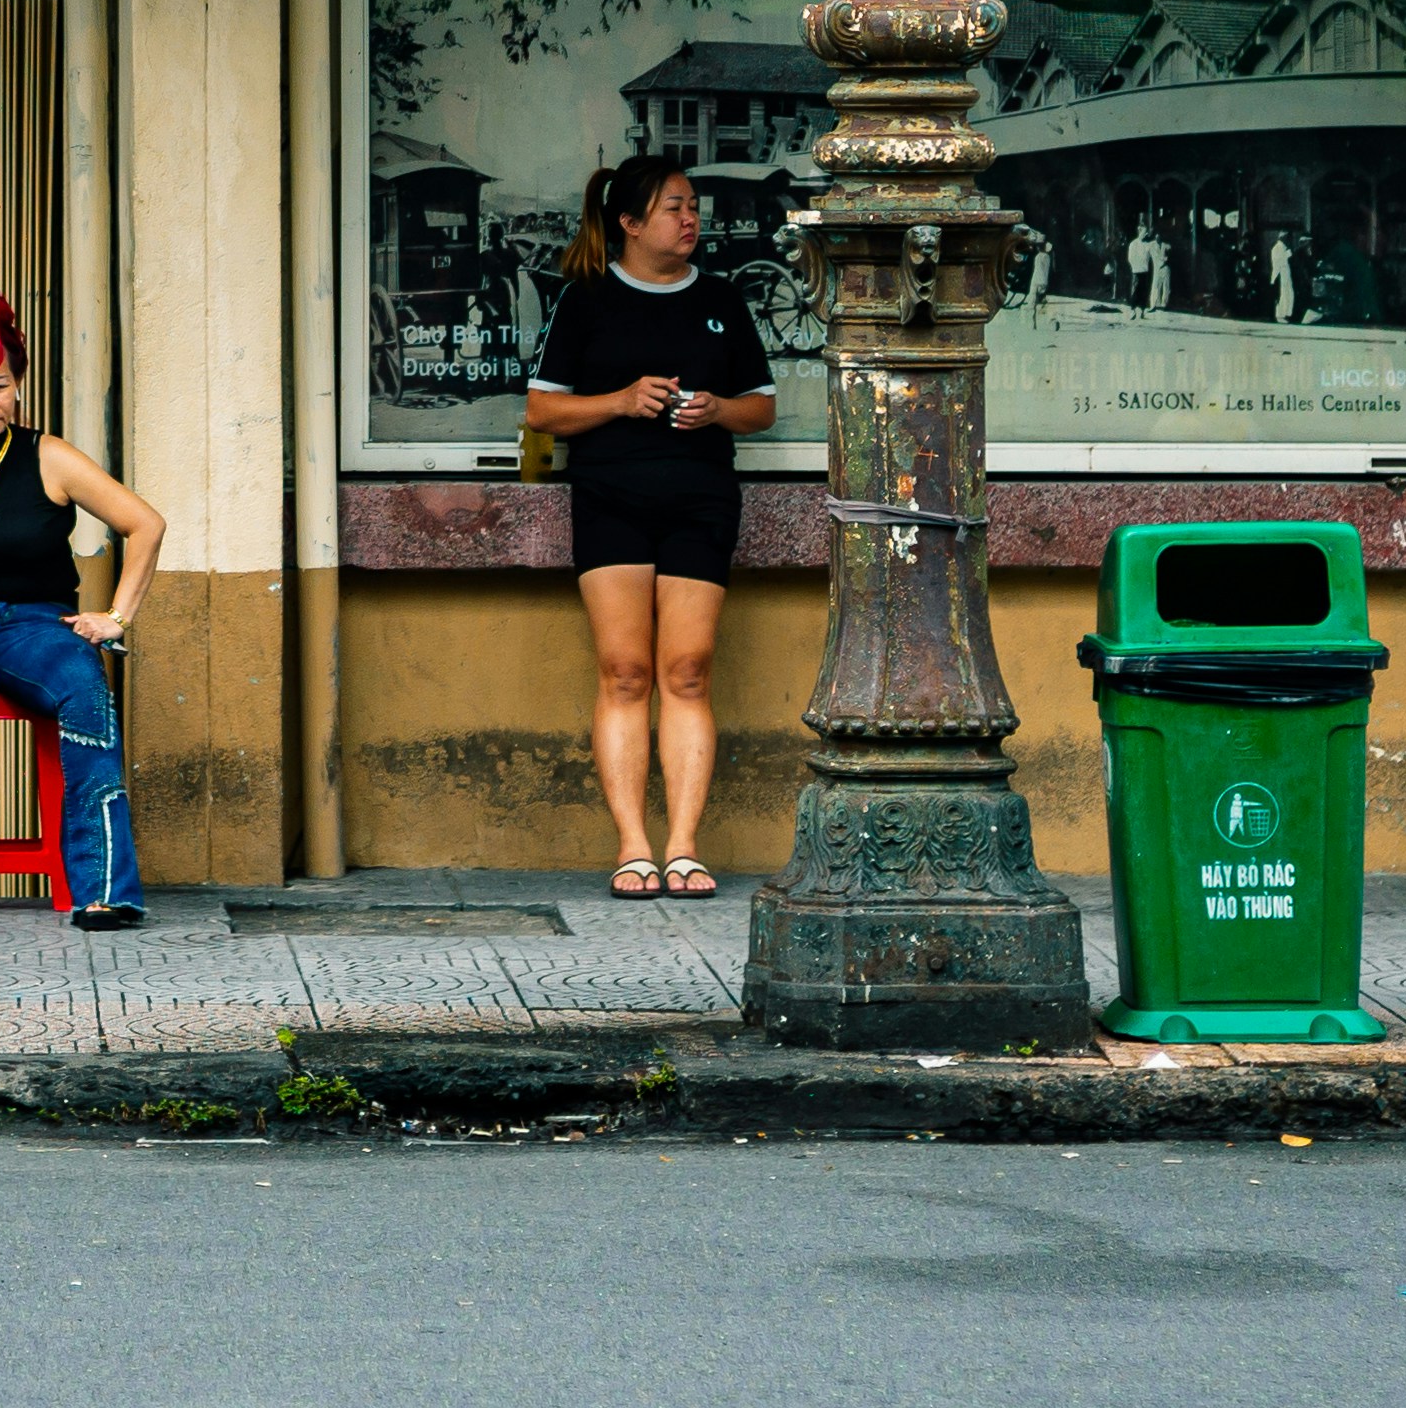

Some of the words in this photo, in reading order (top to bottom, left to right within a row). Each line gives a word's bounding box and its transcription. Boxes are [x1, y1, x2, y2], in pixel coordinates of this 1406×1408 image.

[402, 358, 461, 382] Được
[466, 358, 498, 382] gọi
[504, 358, 523, 377] là
[1320, 369, 1379, 387] LHQC:
[1073, 397, 1098, 414] 33.
[1118, 393, 1200, 411] SAIGON.
[1225, 394, 1254, 412] Les
[1262, 394, 1314, 412] Halles
[1321, 394, 1402, 412] Centrales
[1201, 861, 1233, 888] HÃY
[1237, 856, 1259, 888] BỎ
[1262, 859, 1296, 887] RÁC
[1205, 891, 1238, 920] VÀO
[1242, 891, 1294, 920] THÙNG
